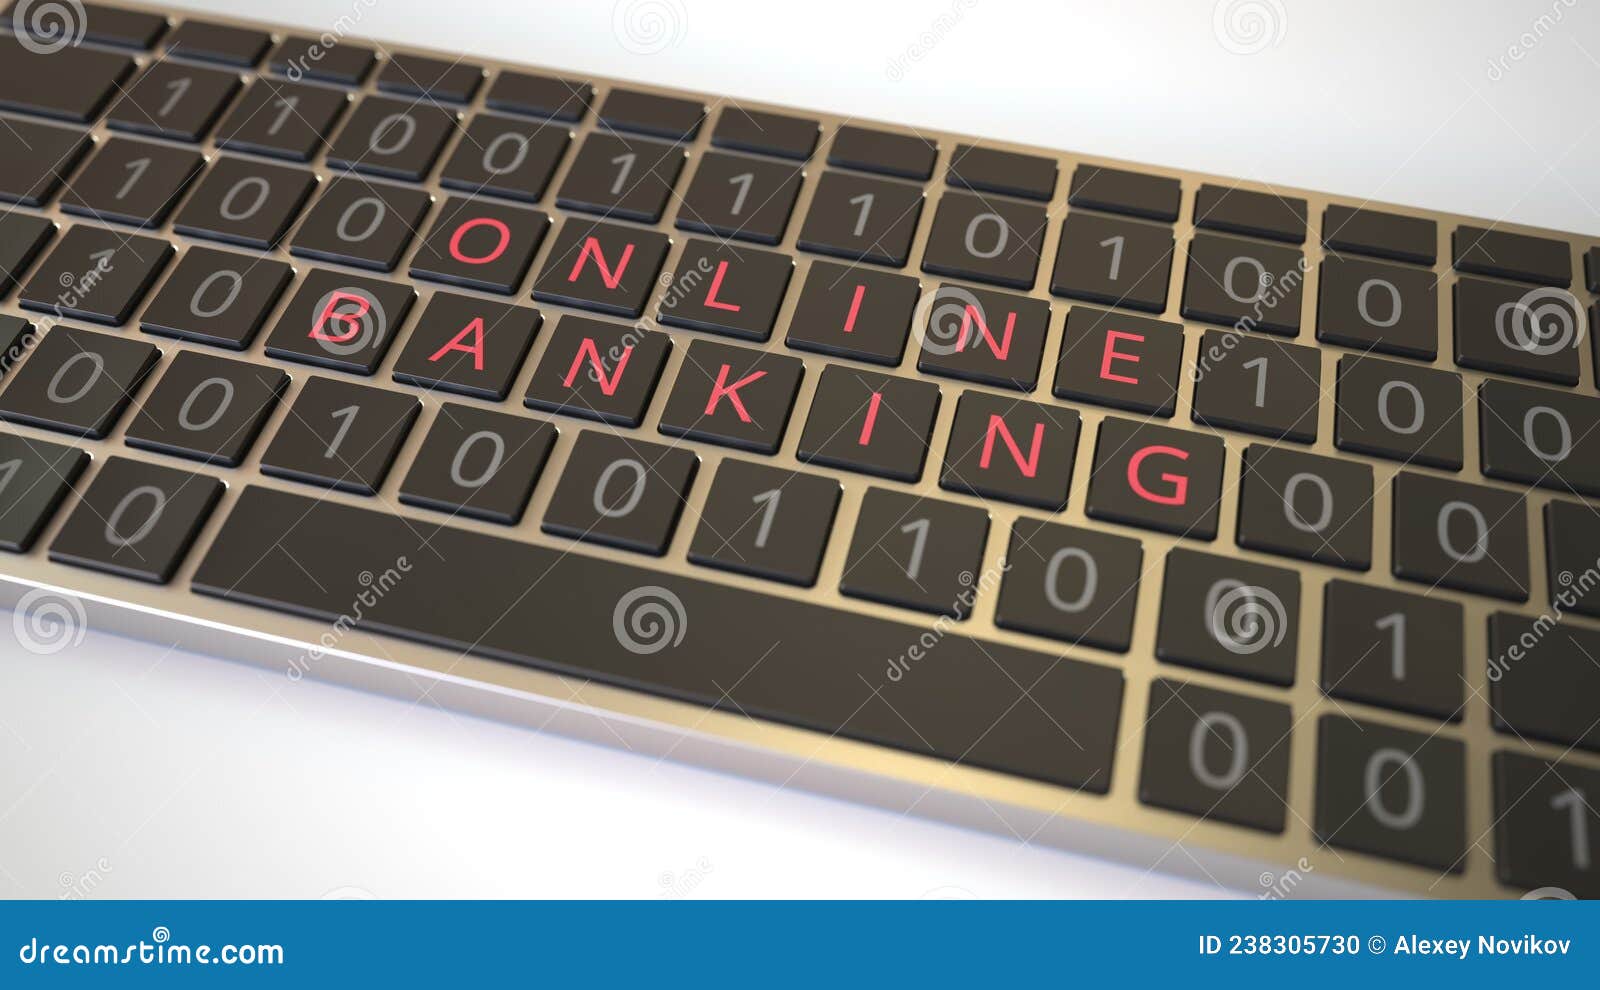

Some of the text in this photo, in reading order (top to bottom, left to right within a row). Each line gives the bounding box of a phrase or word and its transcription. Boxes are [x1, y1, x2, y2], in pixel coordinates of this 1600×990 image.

[115, 158, 151, 200] 1
[219, 176, 270, 221] 0
[336, 197, 386, 242] 0
[1243, 357, 1269, 408] 1
[1376, 380, 1426, 434] 0
[1523, 406, 1572, 462] 0
[160, 77, 193, 117] 1
[269, 96, 299, 136] 1
[369, 113, 417, 155] 0
[483, 132, 529, 175] 0
[610, 153, 638, 195] 1
[728, 173, 755, 215] 1
[849, 193, 875, 236] 1
[964, 213, 1009, 258] 0
[1100, 235, 1126, 281] 1
[1224, 256, 1268, 304] 0
[1357, 278, 1403, 328] 0
[46, 351, 104, 404] 0
[177, 377, 234, 431] 0
[323, 404, 360, 459] 1
[450, 430, 505, 488] 0
[592, 458, 647, 518] 0
[752, 488, 782, 548] 1
[900, 518, 931, 580] 1
[1044, 547, 1098, 613] 0
[1375, 612, 1406, 680] 1
[189, 269, 243, 318] 0
[1283, 472, 1334, 532] 0
[1436, 501, 1489, 563] 0
[104, 485, 167, 546] 0
[1188, 711, 1248, 790] 0
[1363, 748, 1426, 830] 0
[1551, 787, 1590, 869] 1
